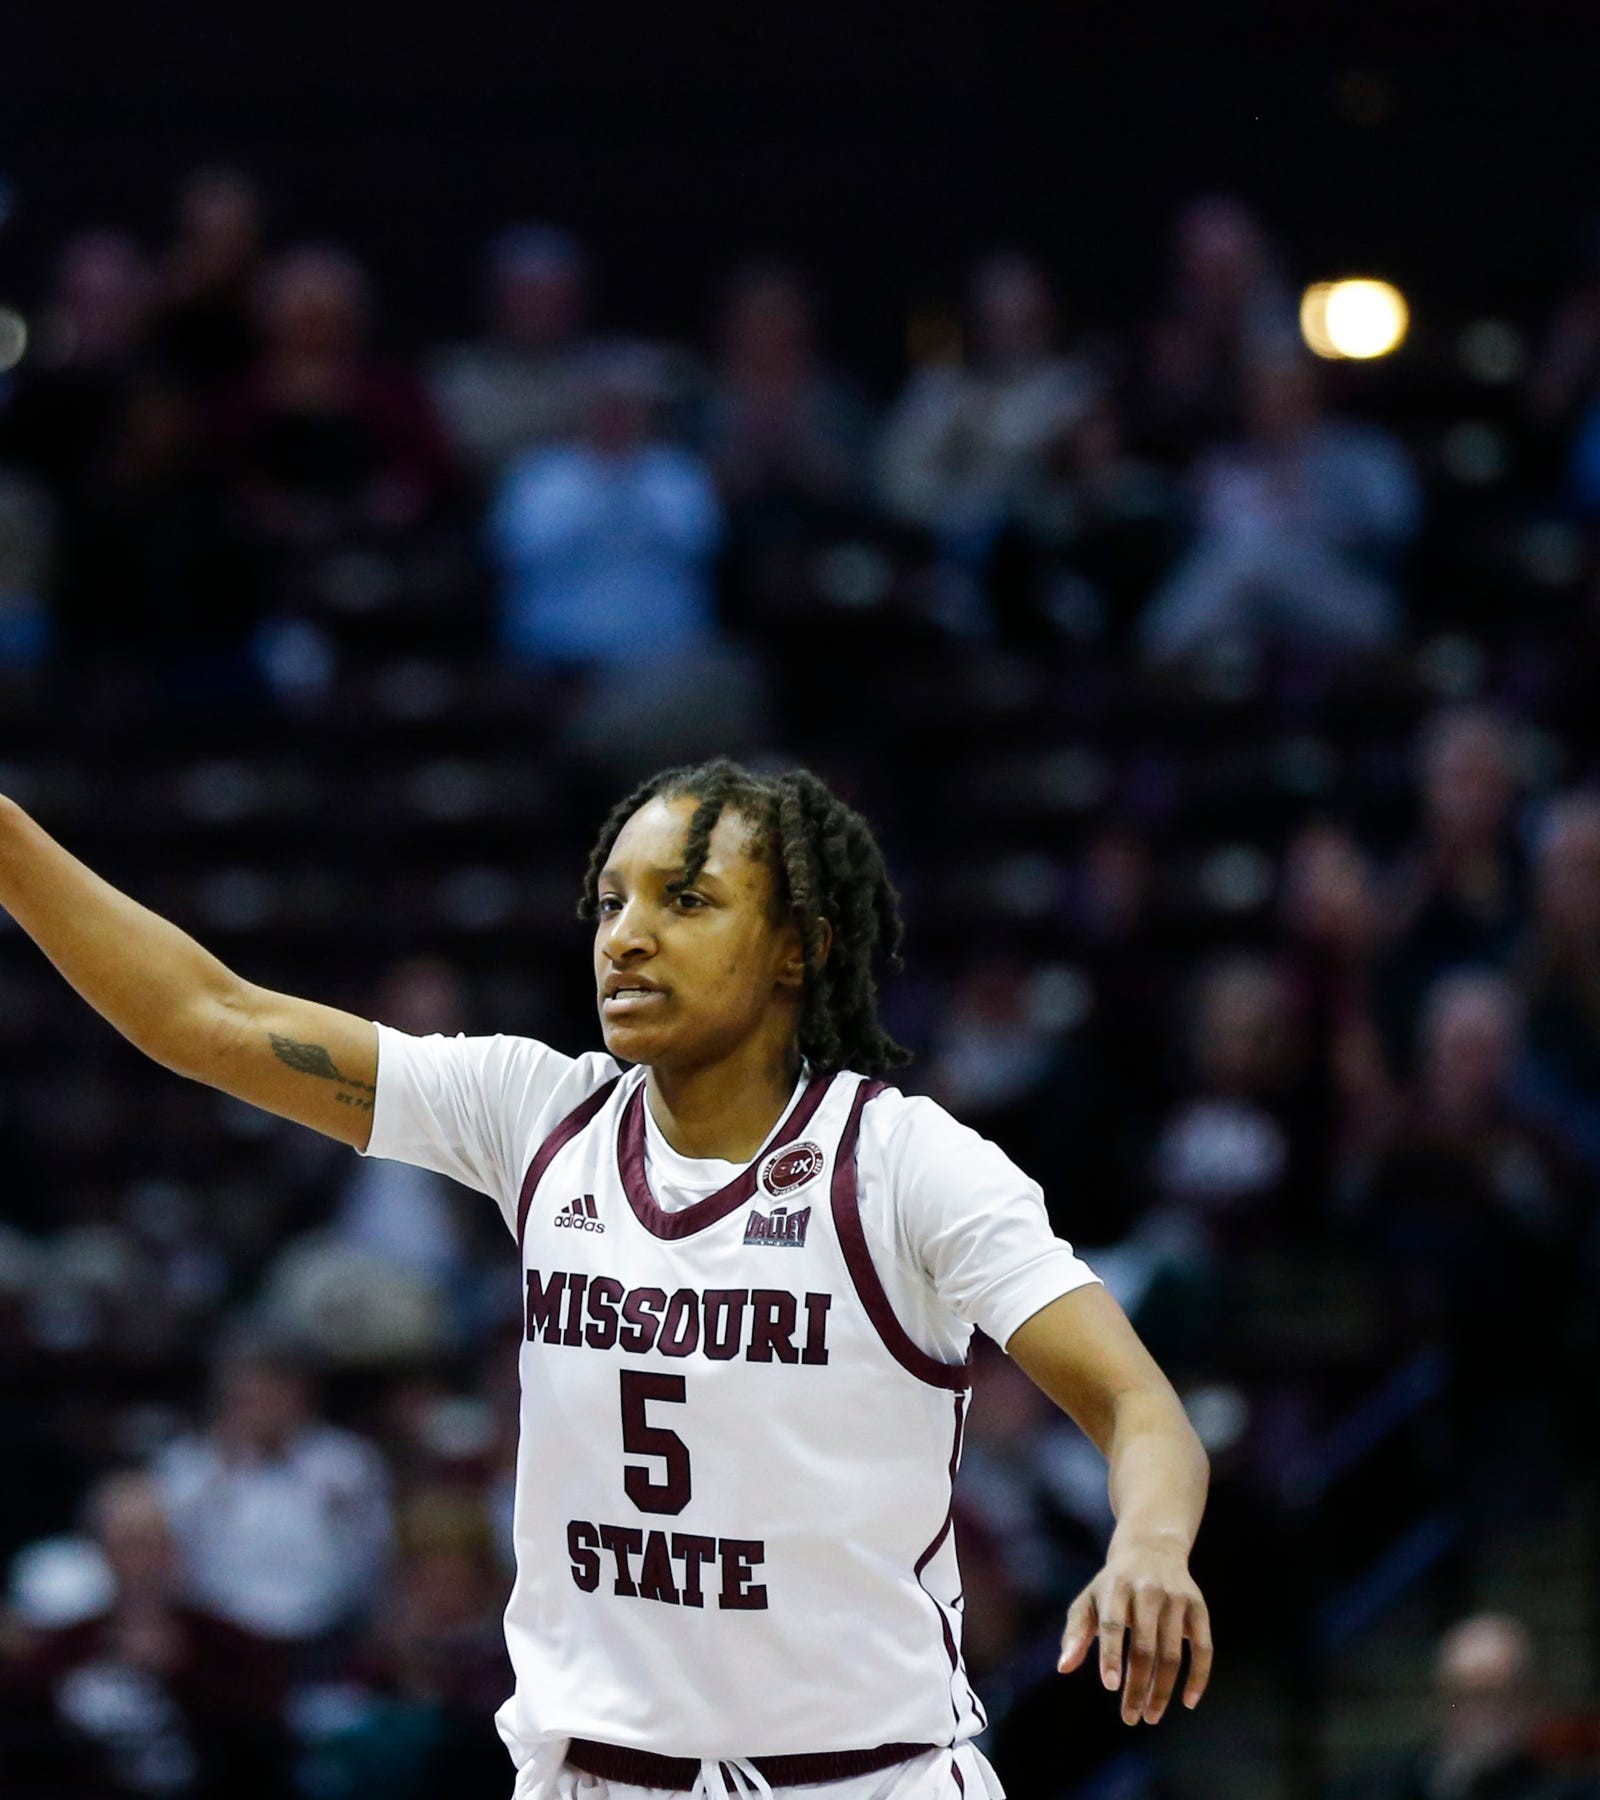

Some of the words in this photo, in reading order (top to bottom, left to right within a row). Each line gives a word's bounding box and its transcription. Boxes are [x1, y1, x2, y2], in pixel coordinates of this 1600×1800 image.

[554, 1213, 606, 1234] adidas
[745, 1206, 811, 1239] VALLEY
[526, 1269, 832, 1365] MISSOURI
[619, 1368, 692, 1516] 5
[566, 1519, 769, 1610] STATE
